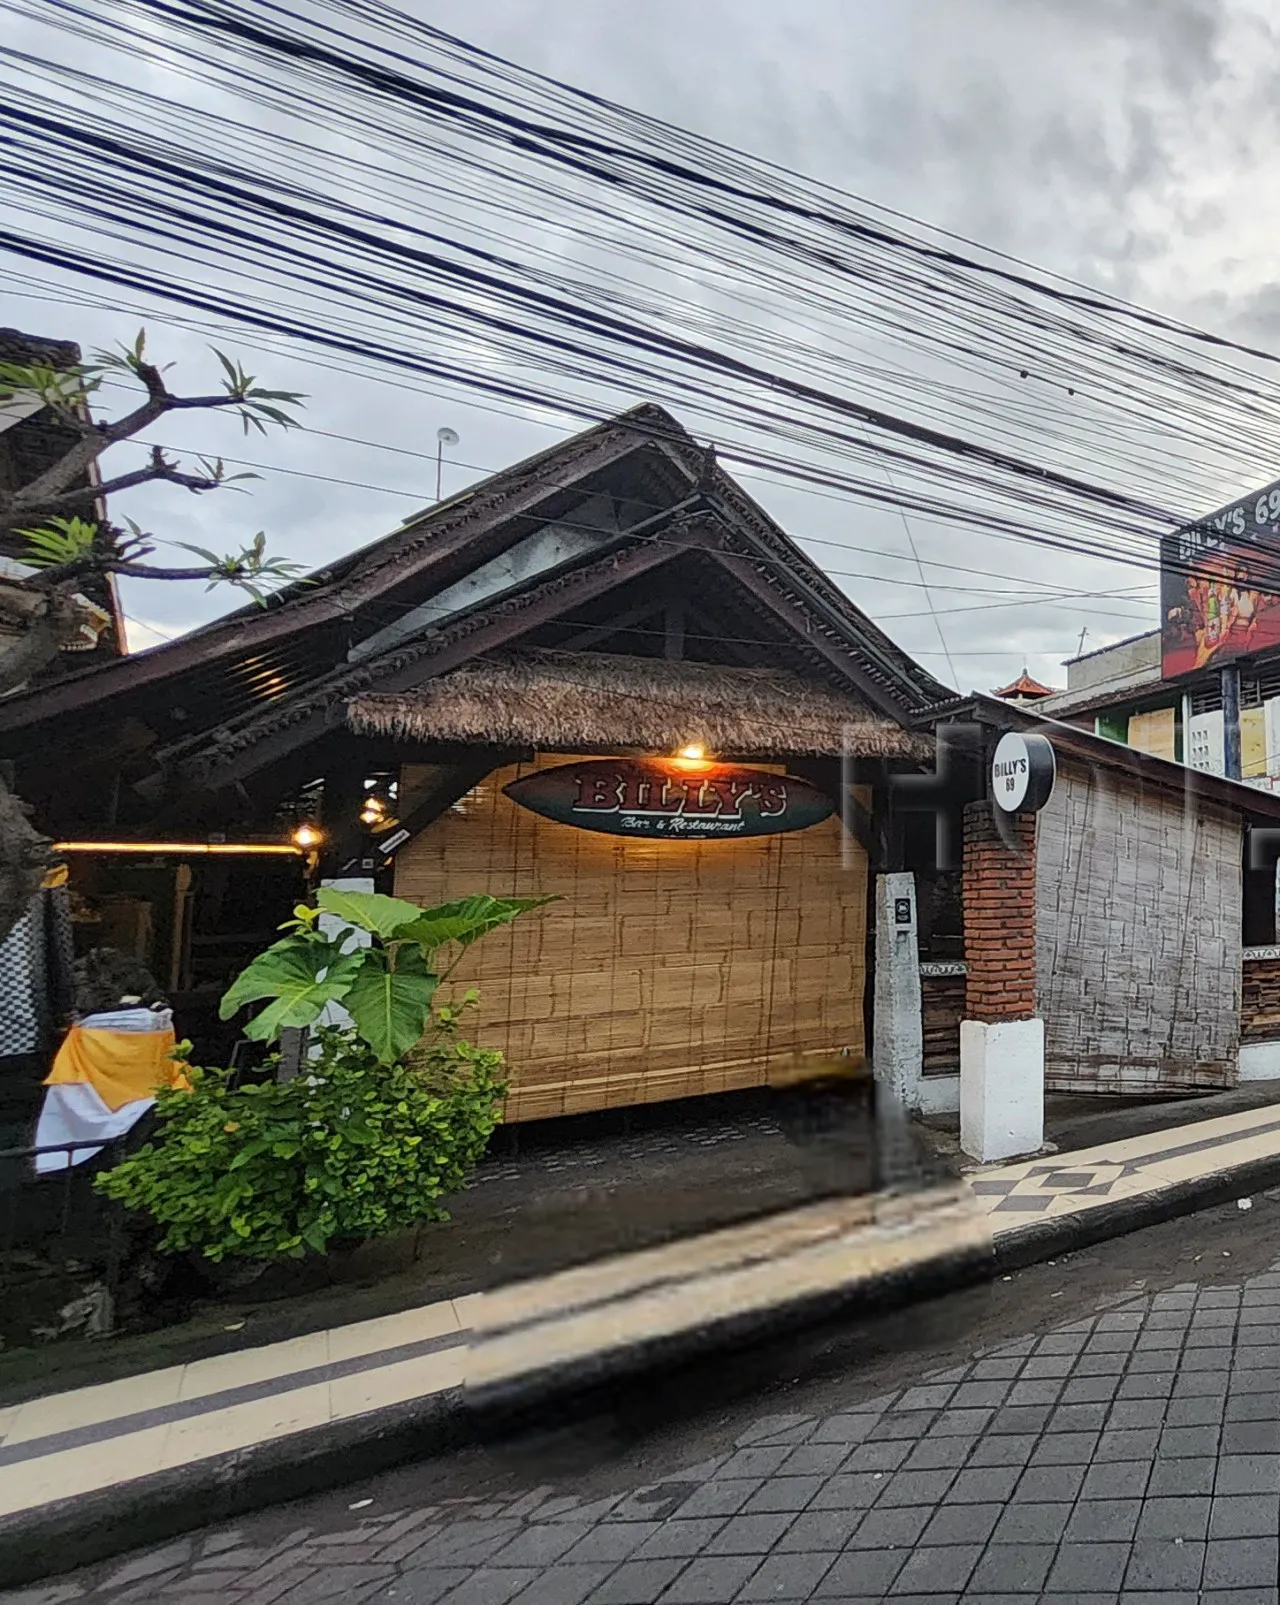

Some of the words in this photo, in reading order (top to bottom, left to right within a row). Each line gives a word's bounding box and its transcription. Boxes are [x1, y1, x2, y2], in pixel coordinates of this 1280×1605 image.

[994, 758, 1027, 778] BILLY'S
[1005, 777, 1015, 792] 69
[572, 774, 787, 819] BILLY'S
[620, 817, 651, 829] Bar
[656, 820, 666, 829] &
[668, 817, 745, 832] Restaurant
